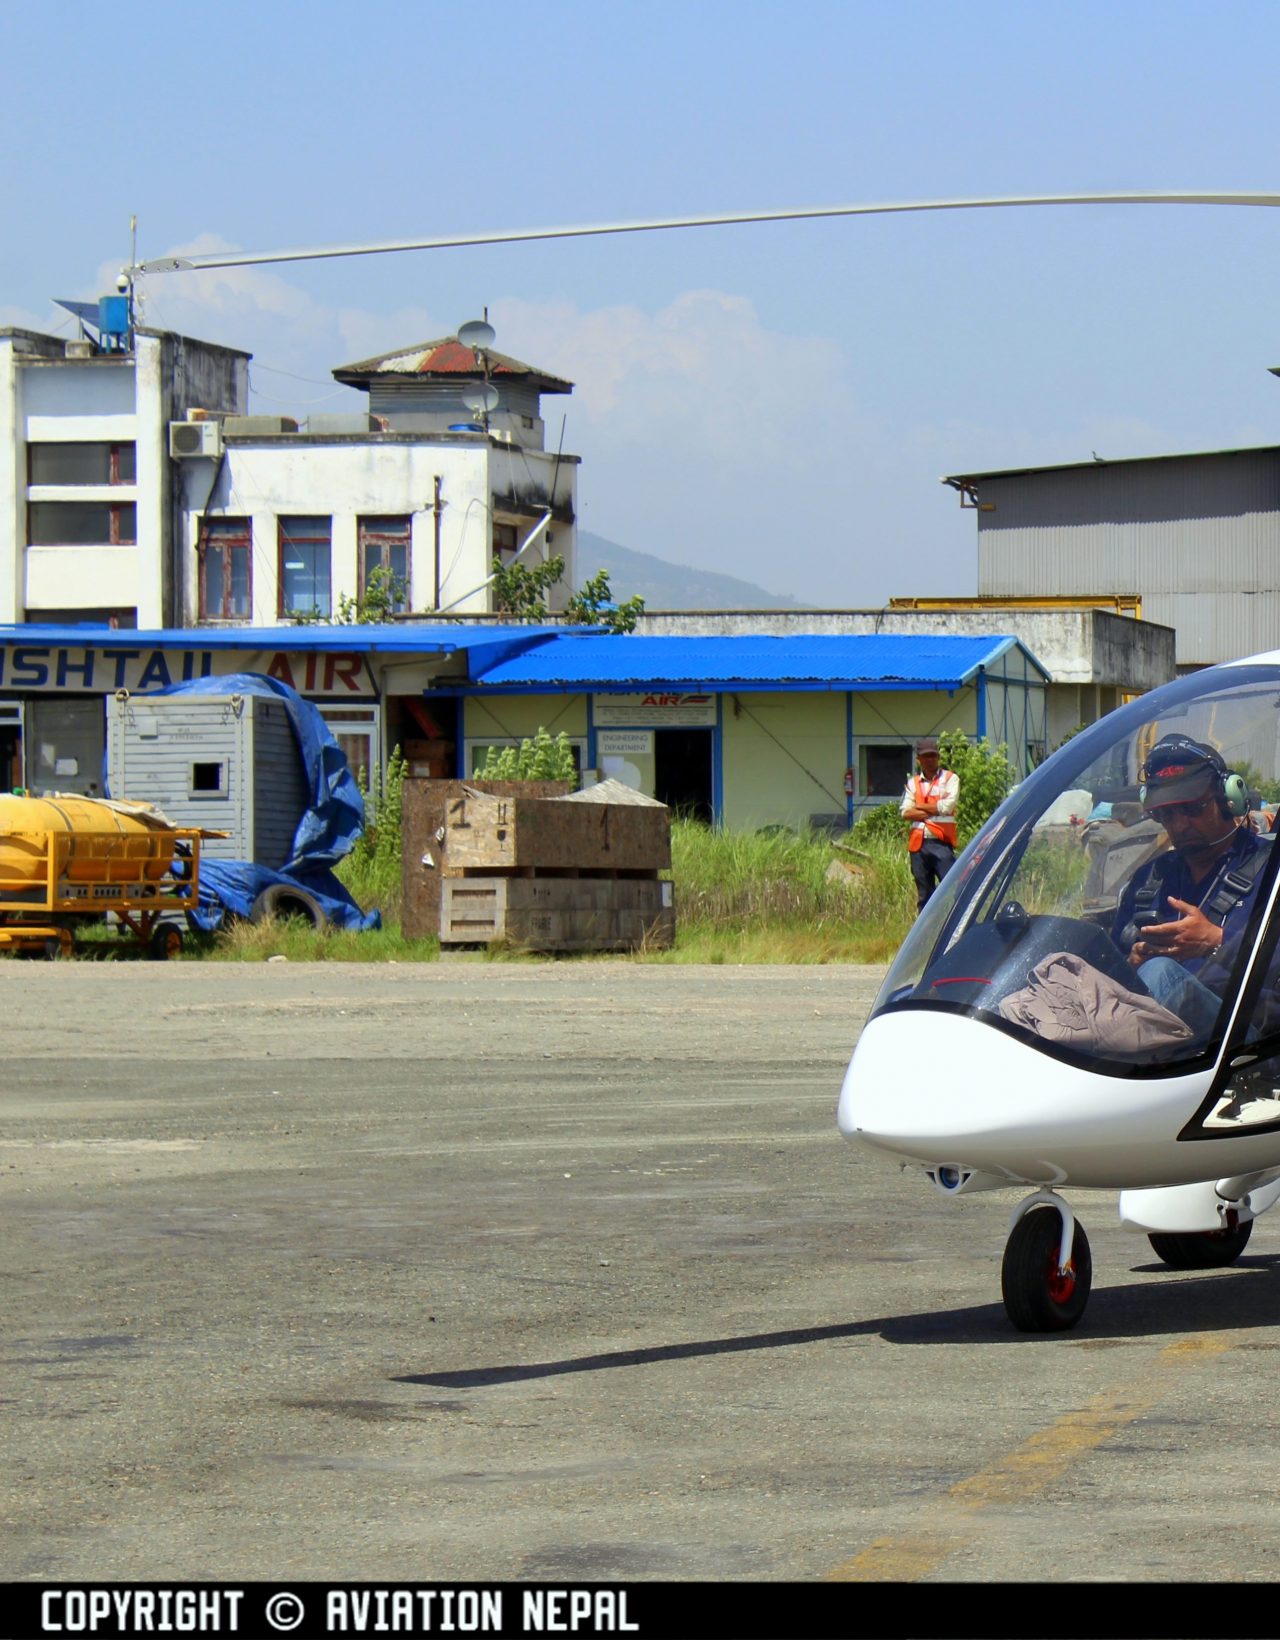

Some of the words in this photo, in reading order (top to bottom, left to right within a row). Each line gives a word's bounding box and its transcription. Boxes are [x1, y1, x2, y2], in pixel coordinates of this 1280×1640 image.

[265, 652, 363, 691] AIR
[641, 696, 682, 706] AIR
[603, 734, 649, 742] ENGINEERING
[604, 744, 646, 752] DEPARTMENT
